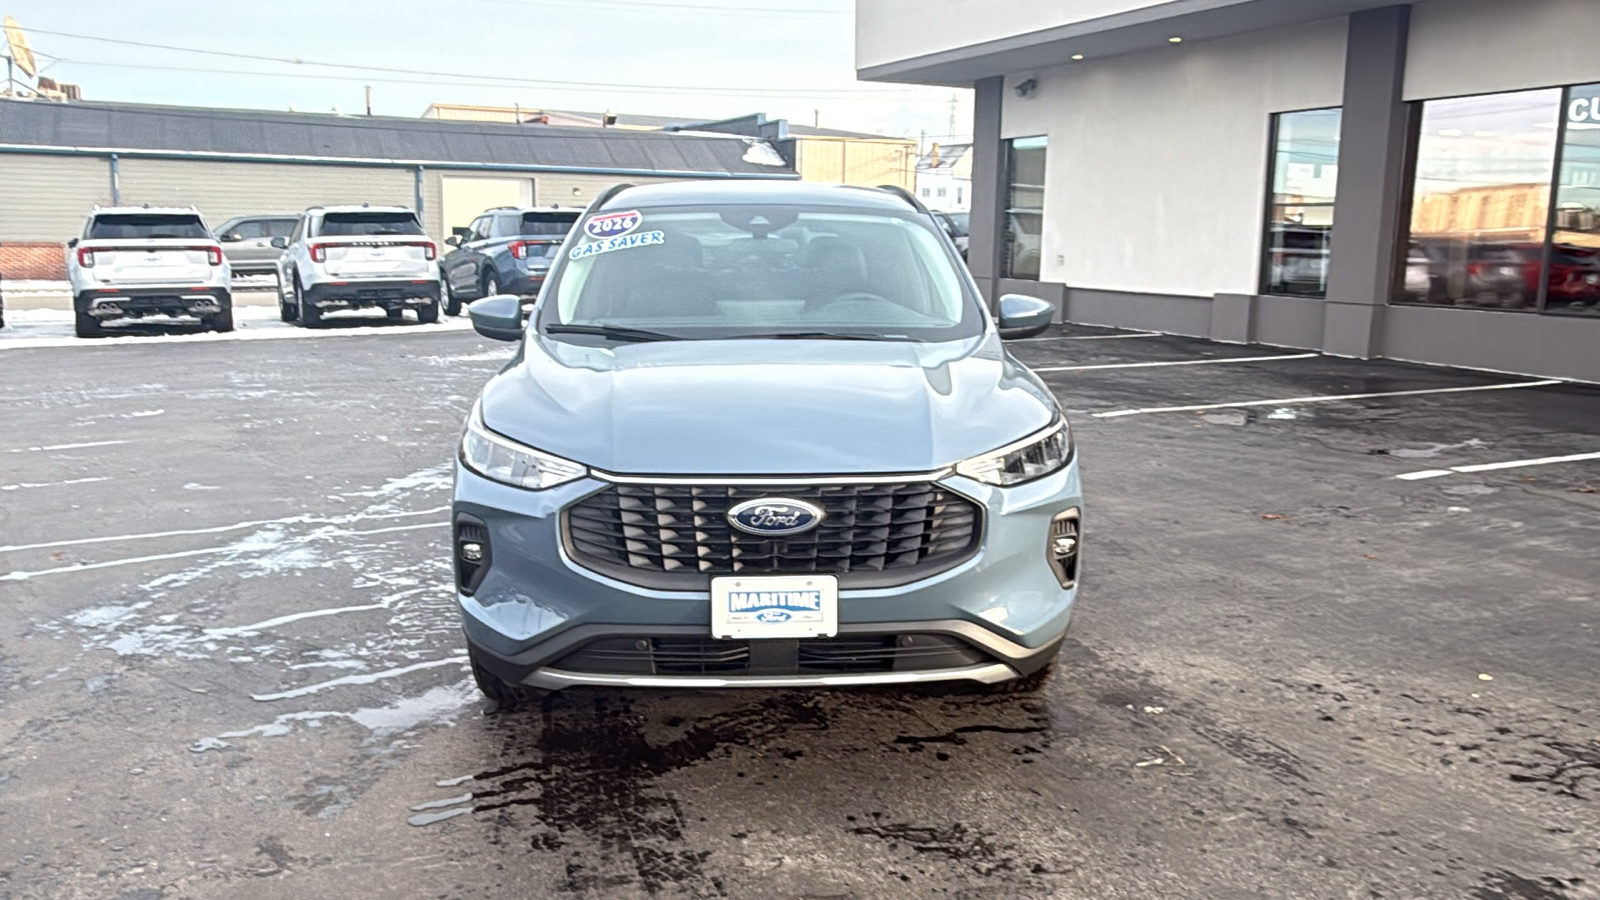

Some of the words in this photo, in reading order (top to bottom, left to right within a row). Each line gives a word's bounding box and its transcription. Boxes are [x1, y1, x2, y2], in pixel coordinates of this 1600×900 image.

[592, 218, 633, 233] 2026
[571, 241, 605, 258] GAS
[608, 232, 661, 250] SAVER
[750, 506, 801, 526] Ford
[731, 592, 820, 611] MARITIME
[760, 612, 788, 623] Ford
